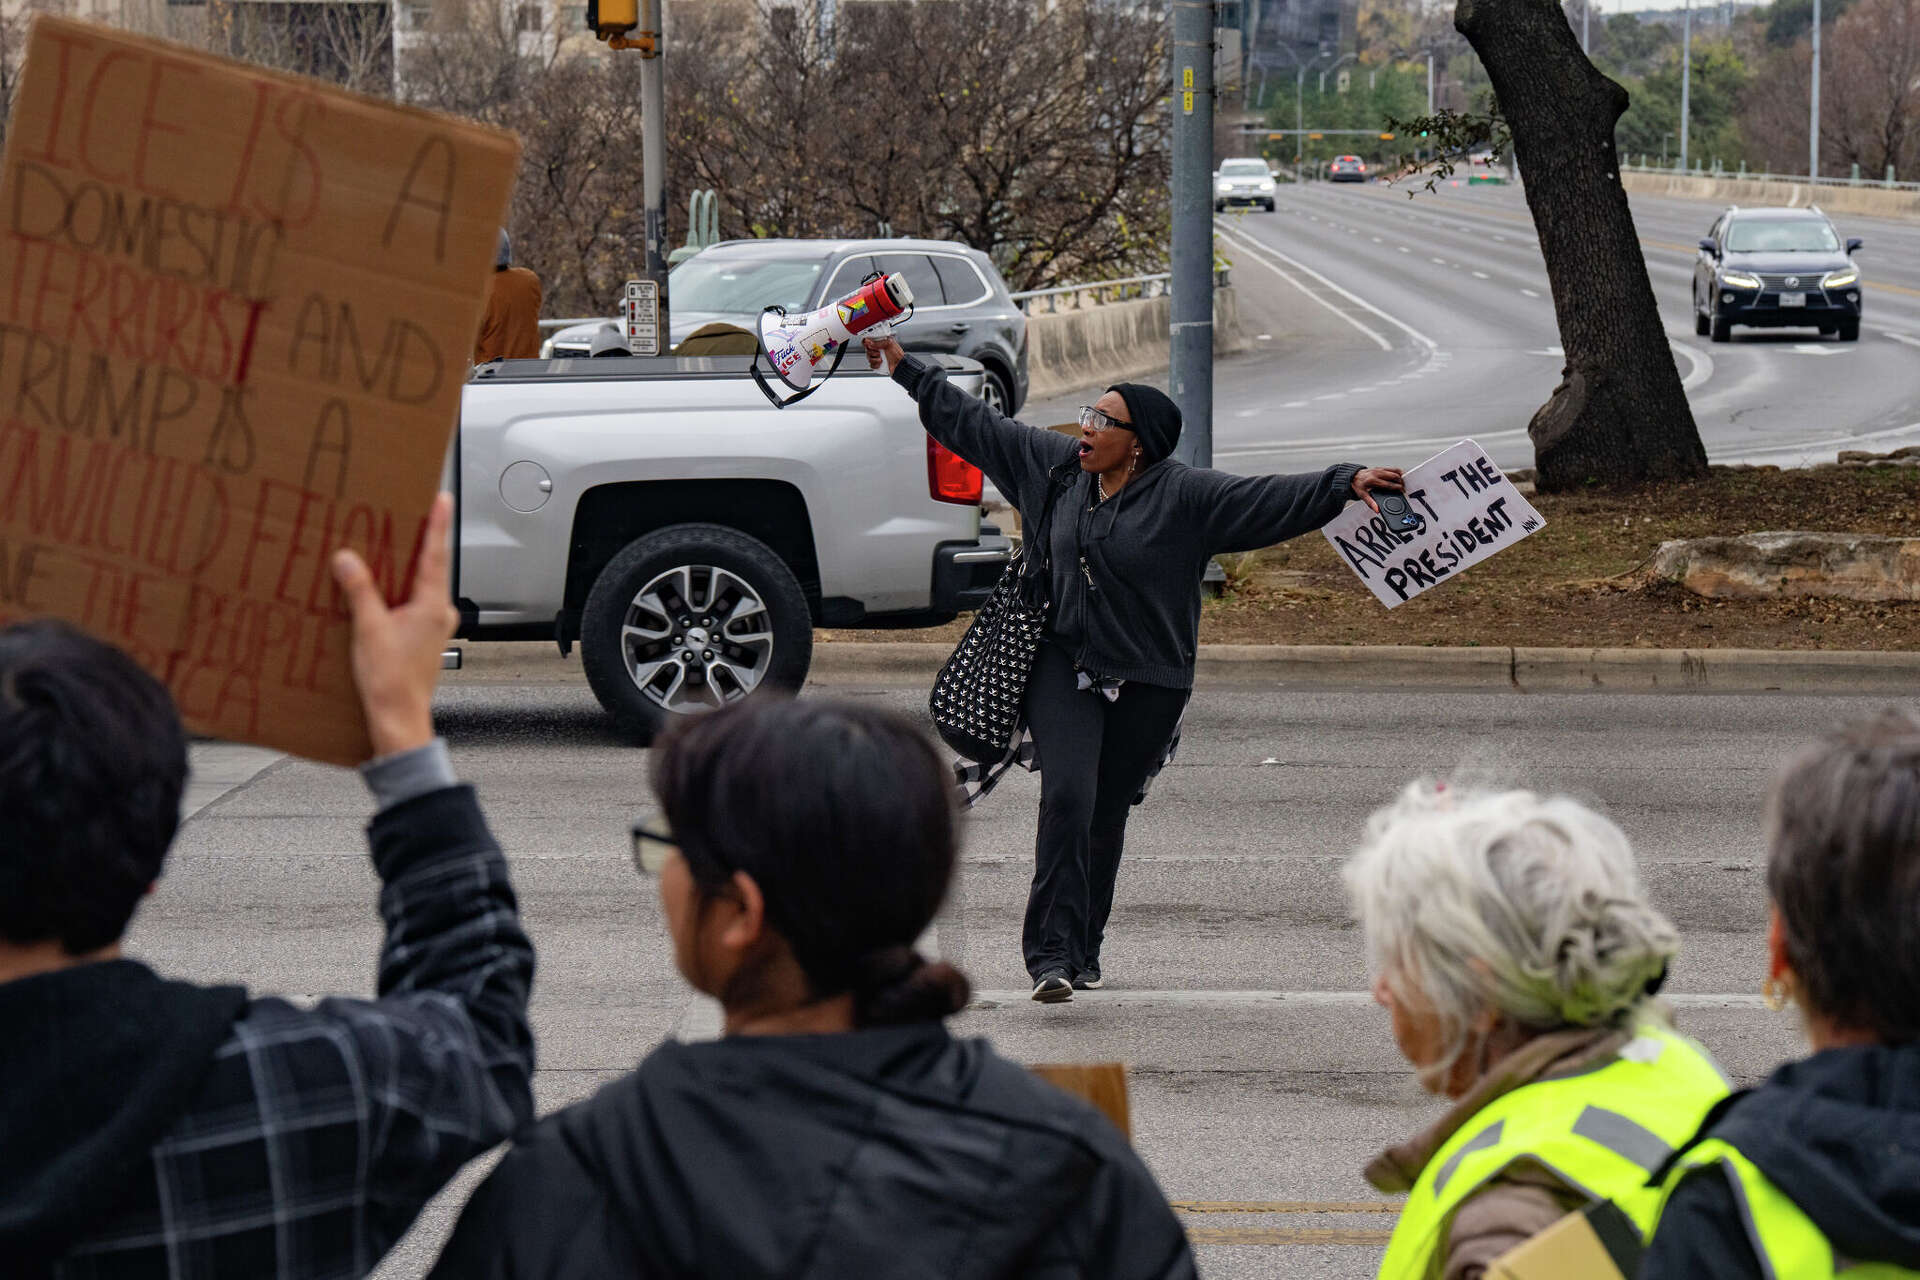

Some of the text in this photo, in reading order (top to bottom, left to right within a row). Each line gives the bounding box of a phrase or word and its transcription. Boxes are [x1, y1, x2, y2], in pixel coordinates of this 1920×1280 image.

[18, 31, 457, 263] ICE IS A
[10, 159, 287, 297] DOMESTIC
[8, 232, 446, 405] TERRORIST AND
[774, 344, 796, 366] Fuck
[781, 351, 801, 370] ICE
[303, 396, 352, 500] A
[1440, 456, 1502, 500] THE
[1384, 496, 1513, 601] PRESIDENT
